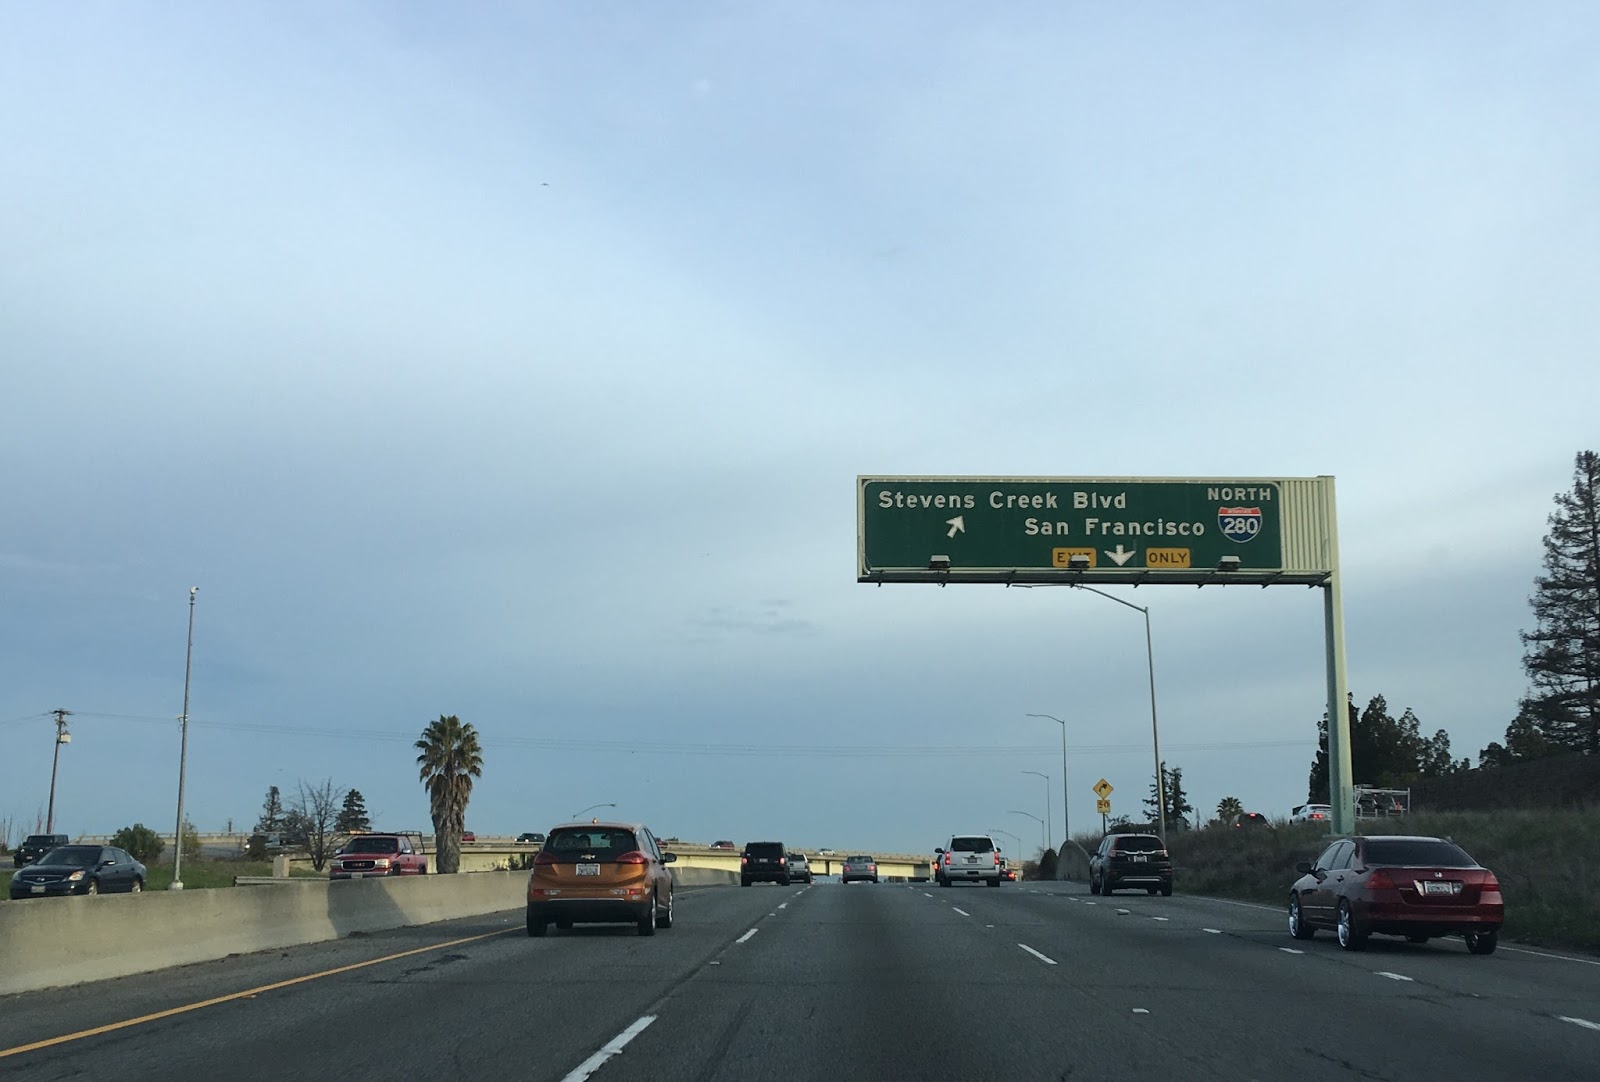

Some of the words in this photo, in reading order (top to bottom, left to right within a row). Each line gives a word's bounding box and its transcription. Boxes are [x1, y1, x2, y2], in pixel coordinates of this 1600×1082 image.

[879, 491, 975, 509] Stevens
[989, 491, 1058, 509] Creek
[1073, 491, 1126, 509] Blvd
[1207, 487, 1272, 501] NORTH
[1024, 517, 1069, 535] San
[1085, 517, 1205, 535] Francisco
[1223, 517, 1258, 534] 280
[1057, 552, 1091, 562] EXT
[1148, 552, 1188, 563] ONLY
